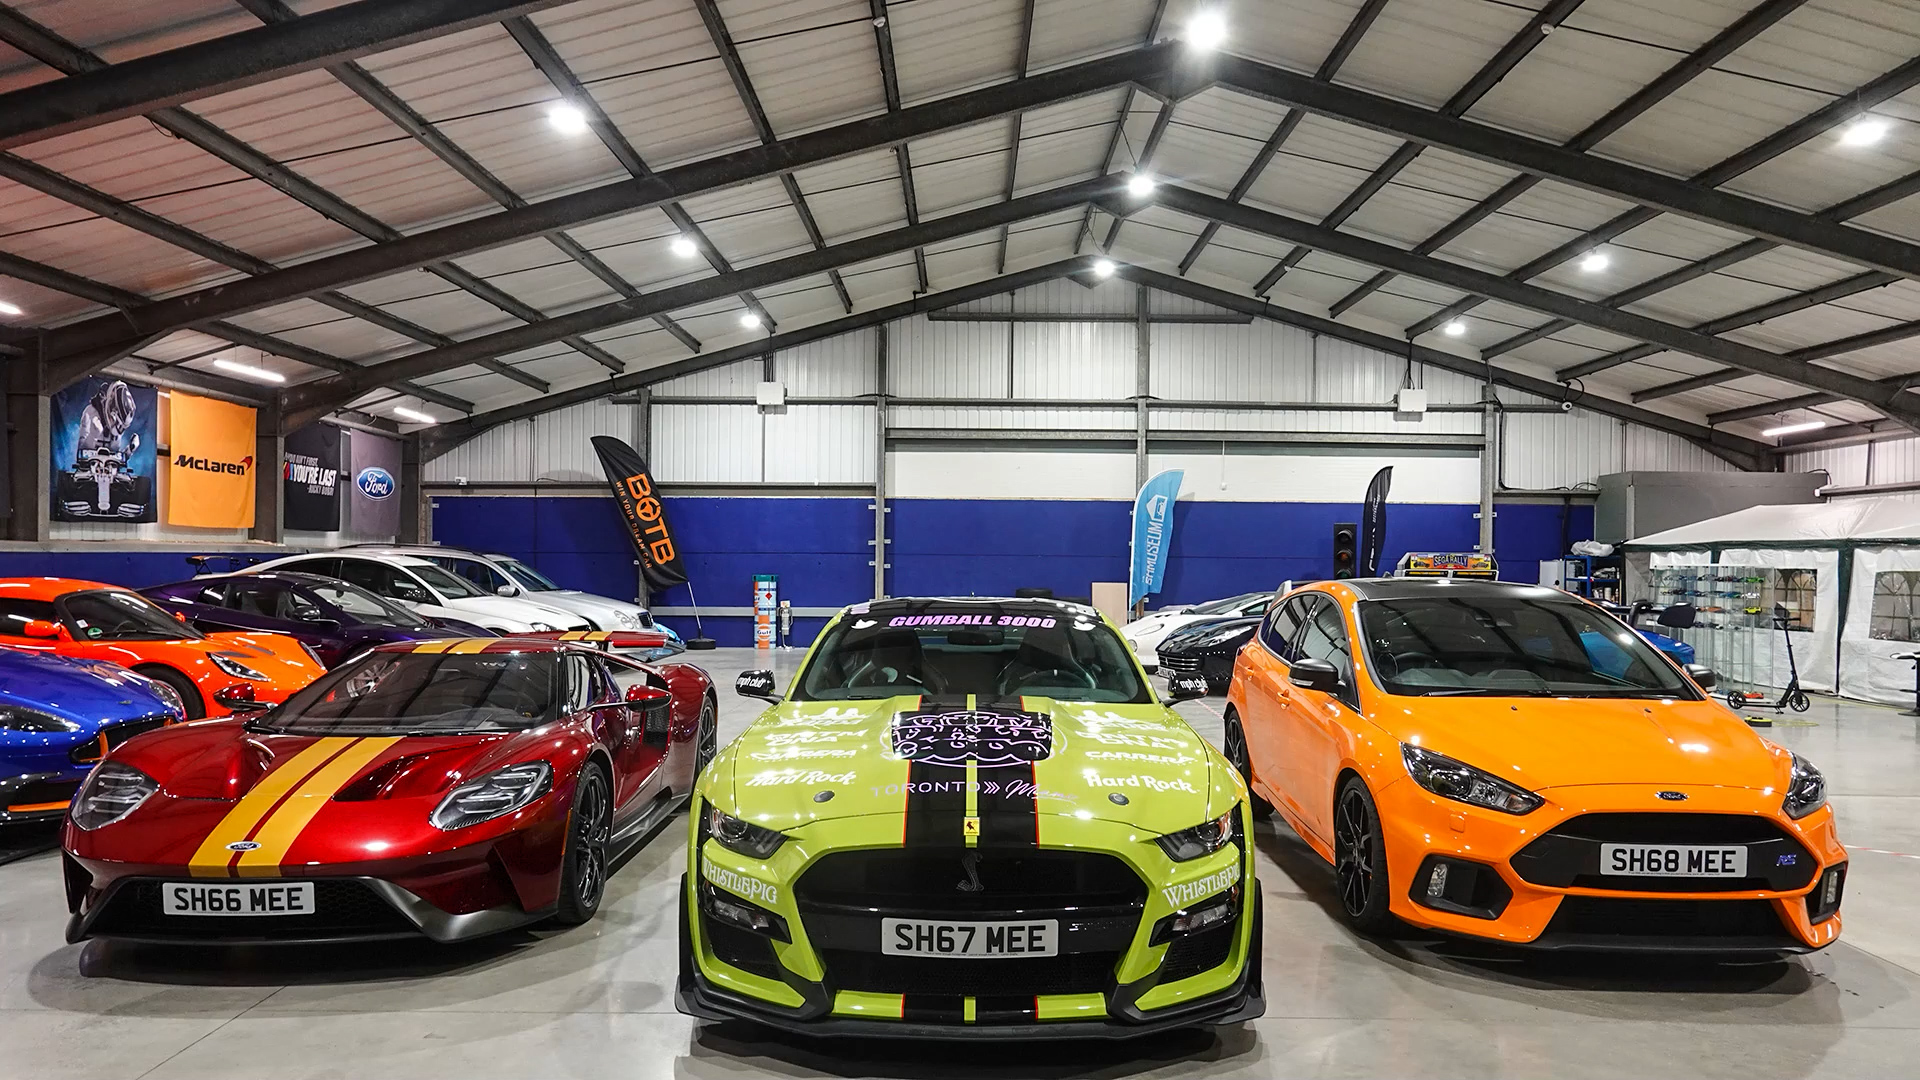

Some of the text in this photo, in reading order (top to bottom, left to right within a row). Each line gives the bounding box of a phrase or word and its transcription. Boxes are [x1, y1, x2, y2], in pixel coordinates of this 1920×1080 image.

[174, 455, 245, 476] McLaren
[318, 467, 337, 487] LAST
[616, 481, 626, 496] WIN
[623, 499, 635, 520] YOUR
[643, 552, 653, 569] CAR
[626, 473, 676, 565] BOTB
[1449, 554, 1468, 567] RALLY
[888, 615, 1057, 629] GUMBALL 3000
[800, 770, 857, 785] Rock
[1083, 772, 1198, 794] Hard Rock
[871, 781, 981, 797] TORONTO
[1612, 848, 1737, 873] SH68 MEE
[174, 887, 304, 912] SH66 MEE
[895, 923, 1046, 953] SH67 MEE
